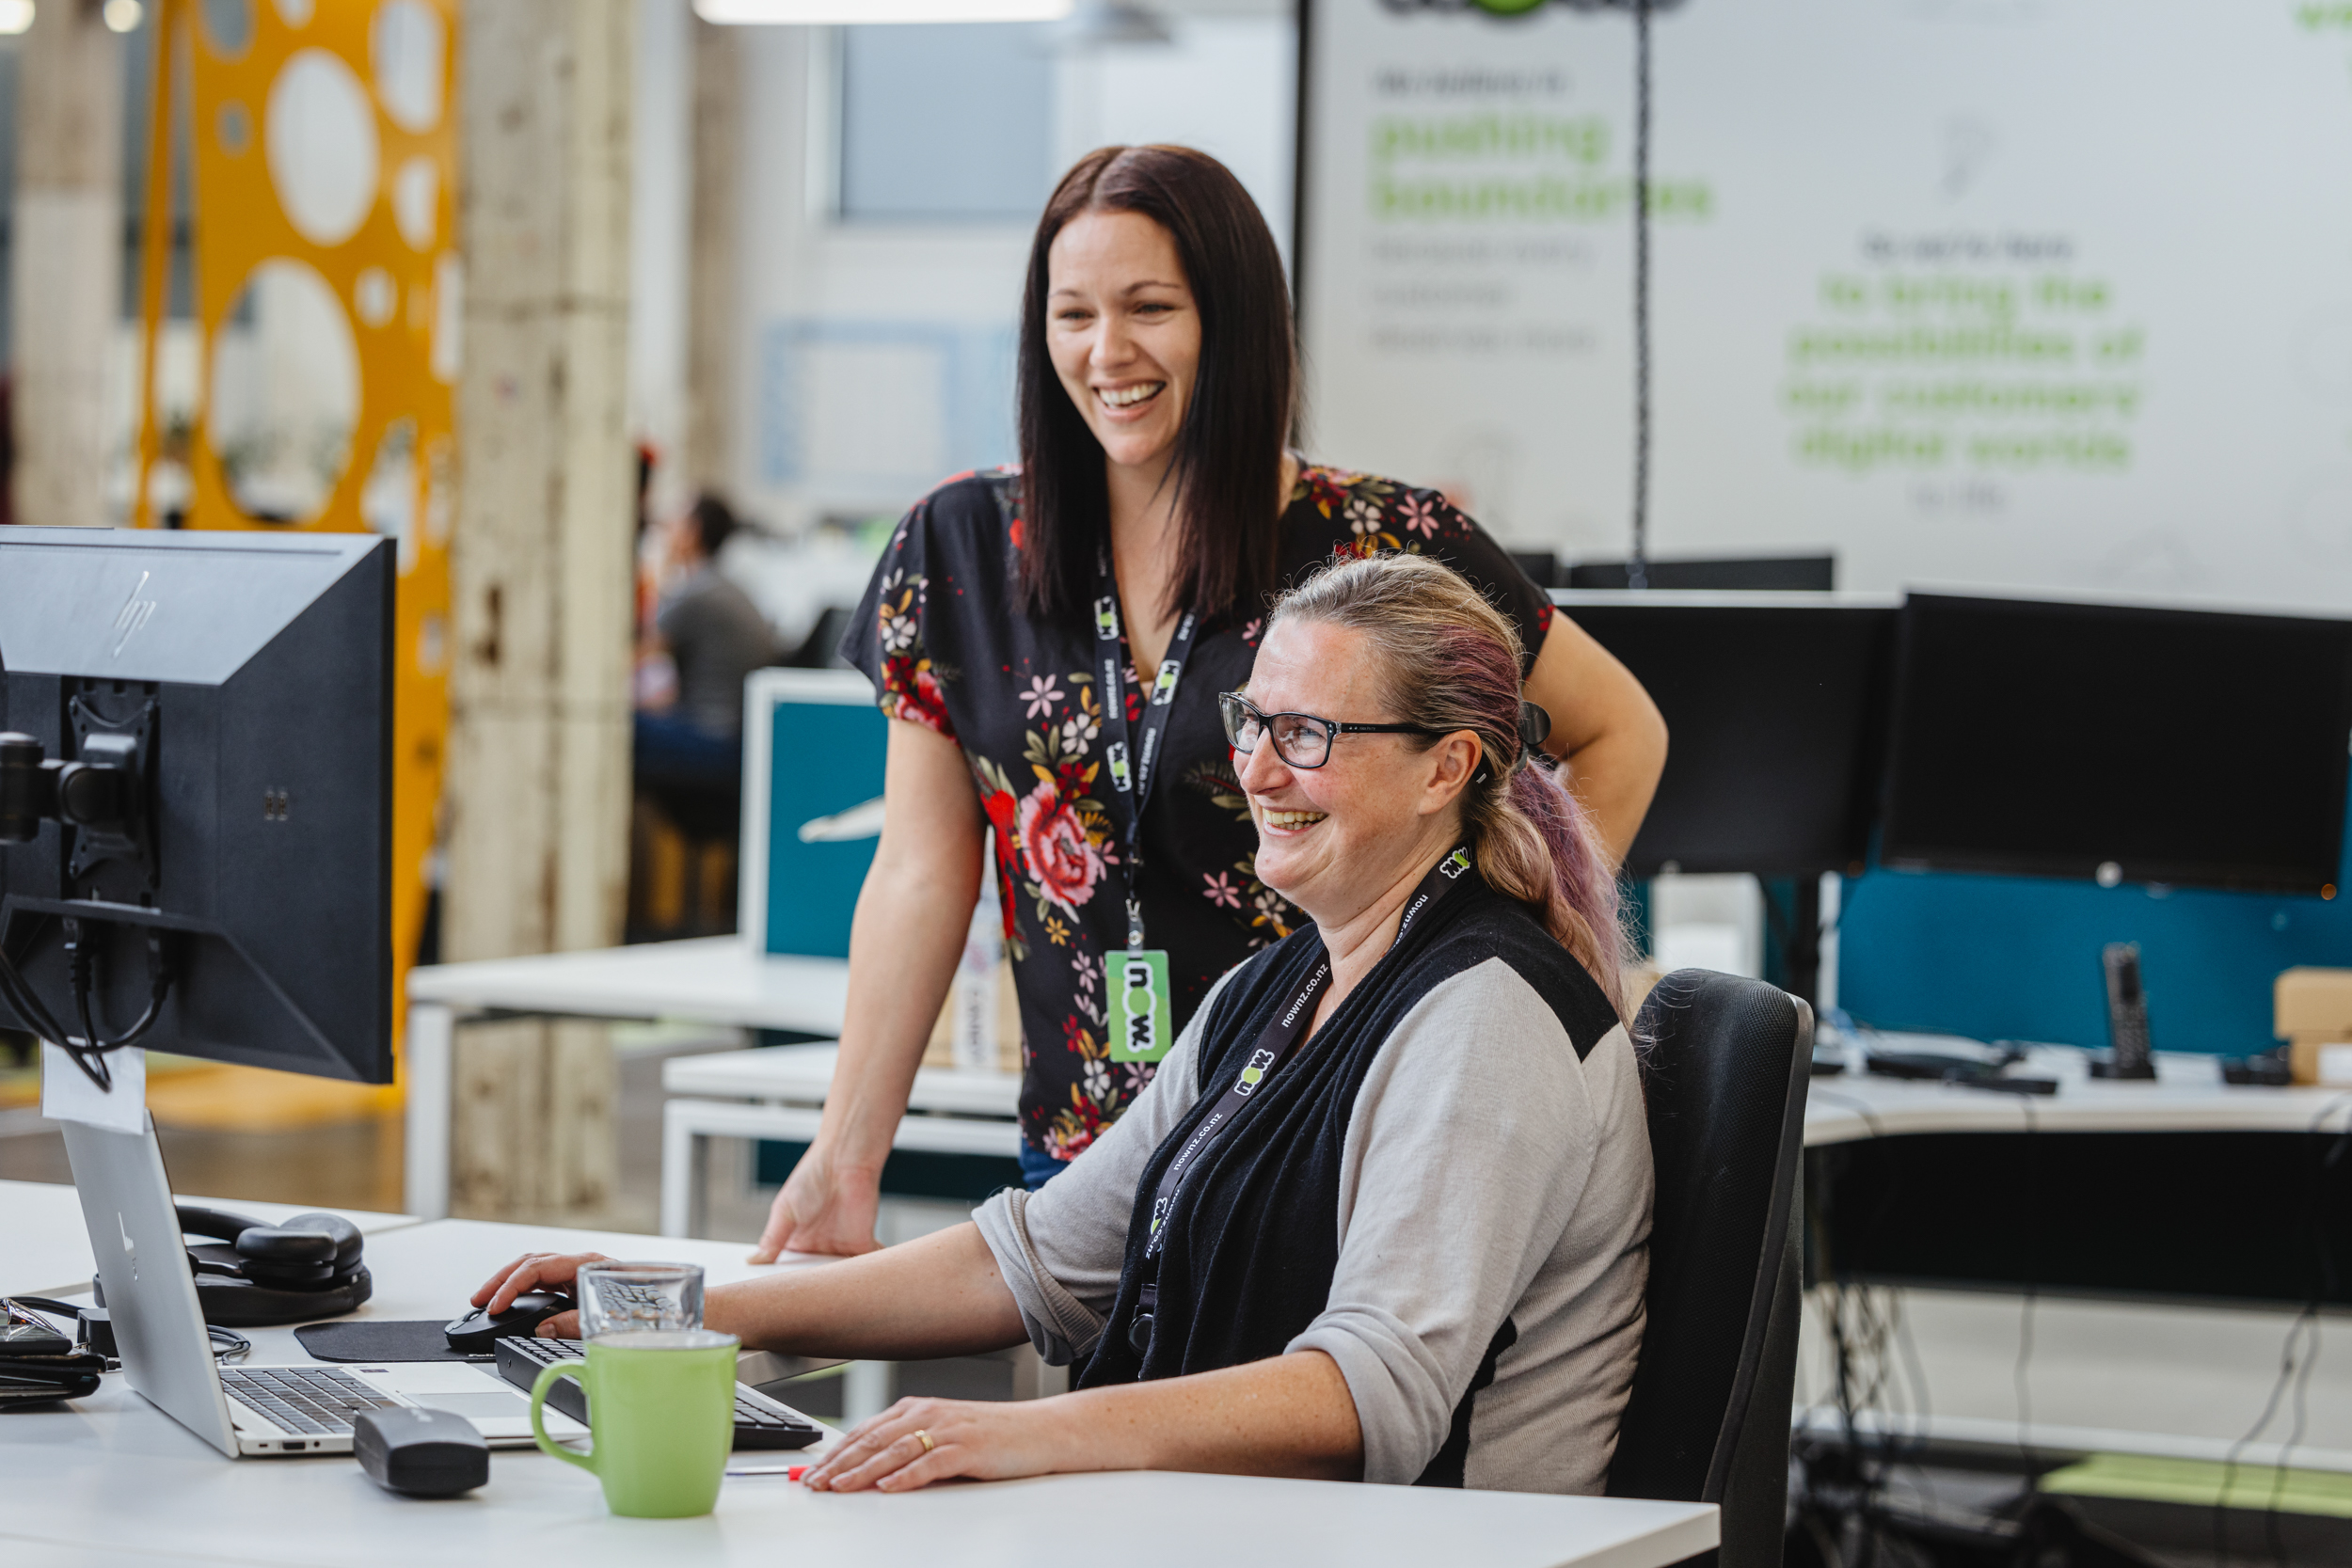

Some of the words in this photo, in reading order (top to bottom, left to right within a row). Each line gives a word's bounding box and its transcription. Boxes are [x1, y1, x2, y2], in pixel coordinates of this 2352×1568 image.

[1372, 109, 1609, 168] pushing
[1373, 171, 1712, 221] boundares
[1821, 274, 1871, 312] to
[1883, 274, 2019, 322] bring
[2032, 275, 2114, 313] the
[1789, 323, 2081, 369] possibilities
[2090, 324, 2146, 365] of
[1779, 380, 1867, 412] our
[1793, 421, 1951, 471] digital
[1963, 425, 2136, 469] worlds
[1281, 963, 1328, 1028] nownz.co.nz
[1173, 1112, 1223, 1171] nownz.co.nz
